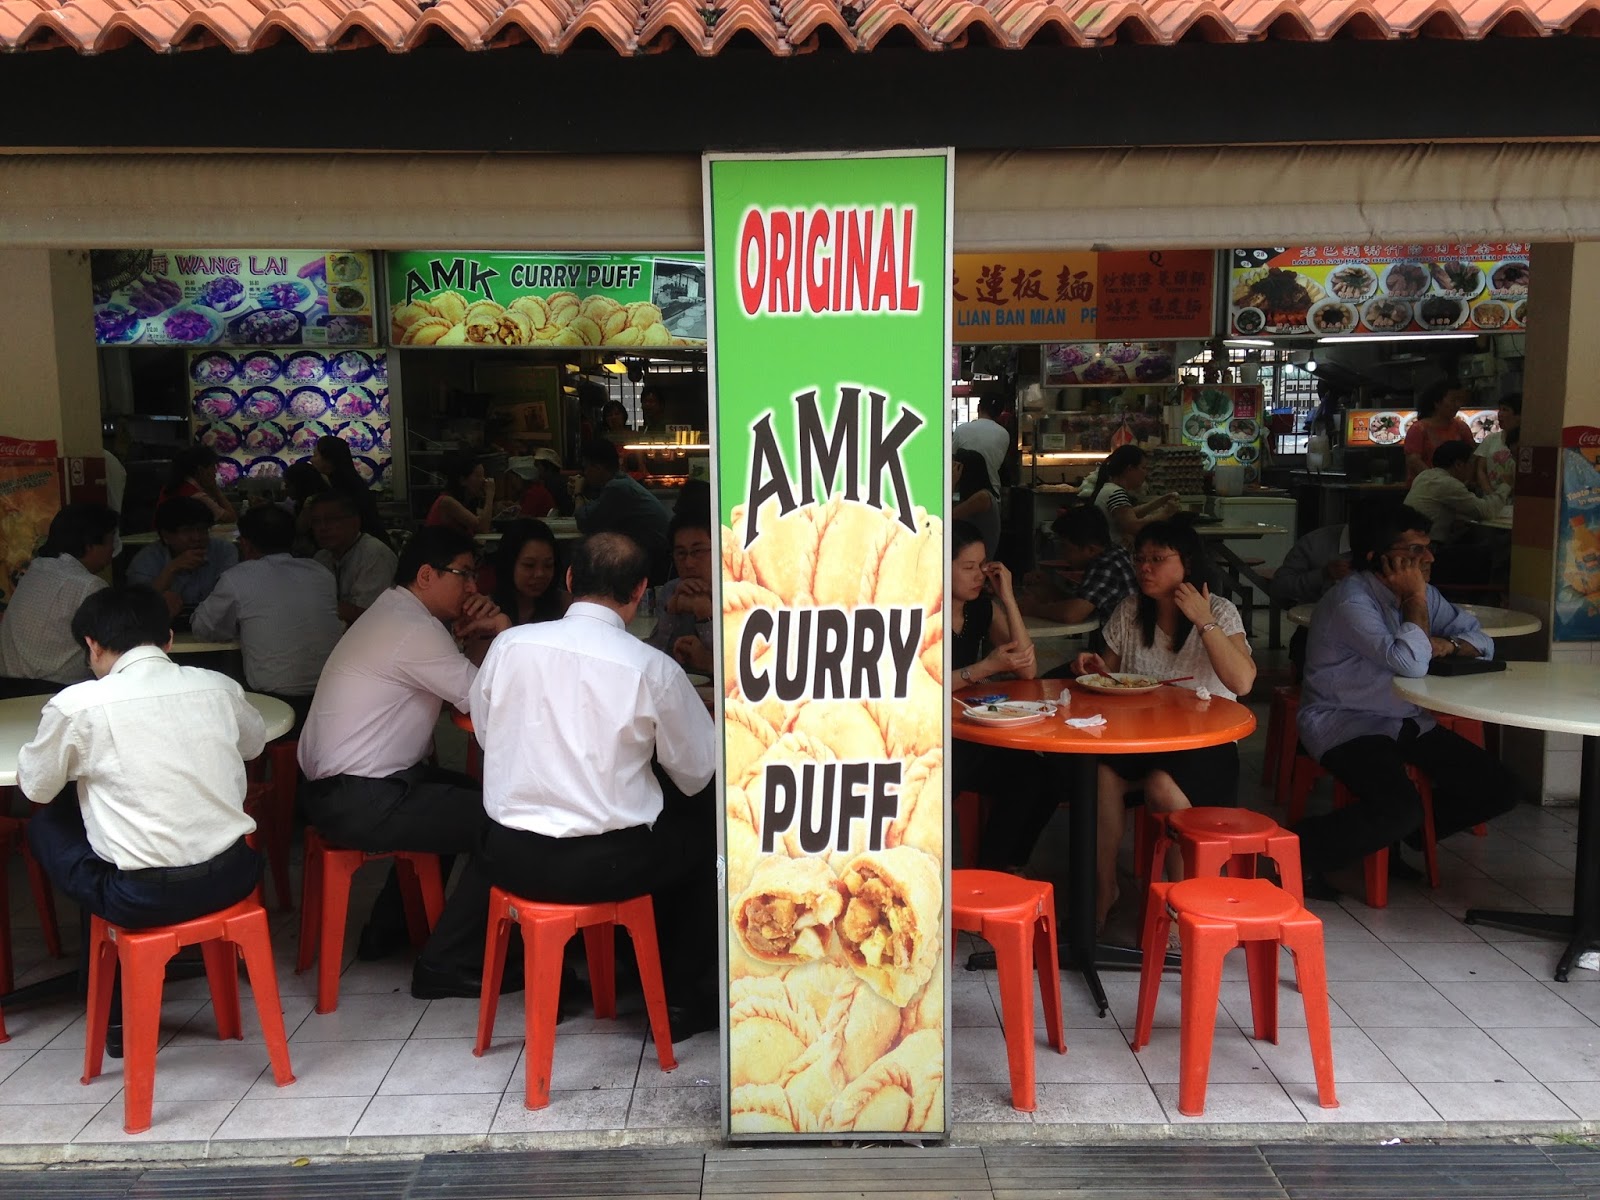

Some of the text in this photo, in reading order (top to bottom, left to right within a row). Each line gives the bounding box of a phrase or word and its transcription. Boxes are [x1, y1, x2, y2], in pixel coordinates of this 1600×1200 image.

[175, 255, 288, 276] WANG LAI
[406, 258, 500, 307] AMK
[510, 264, 641, 288] CURRY PUFF
[739, 207, 920, 315] ORIGINAL
[1149, 251, 1163, 267] Q
[957, 309, 991, 326] LIAN
[995, 309, 1025, 326] BAN
[1030, 308, 1066, 325] MIAN
[743, 386, 923, 550] AMK
[739, 607, 923, 702] CURRY
[761, 762, 902, 853] PUFF
